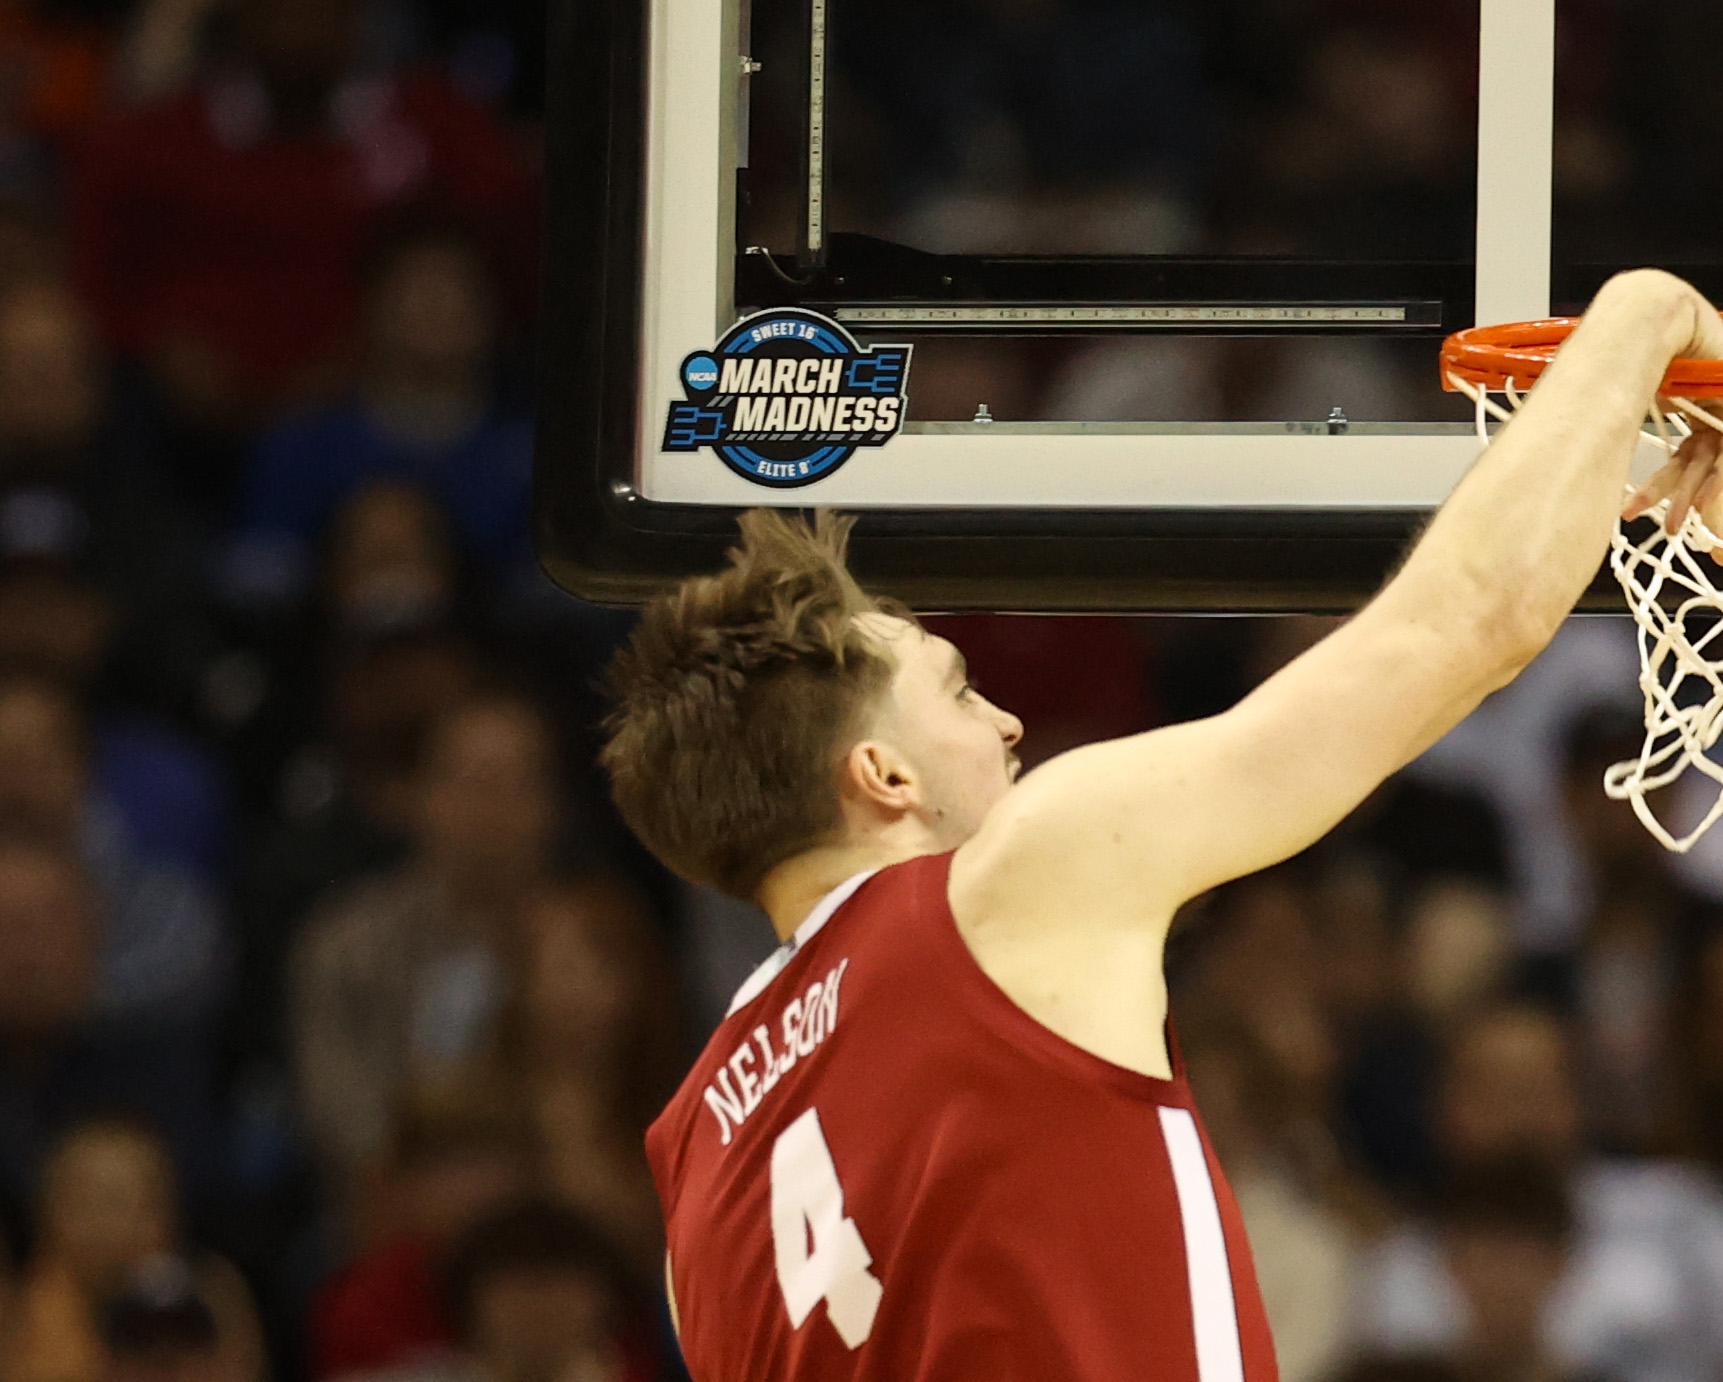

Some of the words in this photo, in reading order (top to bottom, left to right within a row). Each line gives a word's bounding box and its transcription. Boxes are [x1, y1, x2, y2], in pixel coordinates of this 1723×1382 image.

[751, 322, 796, 342] SWEET
[798, 324, 817, 340] 16
[687, 370, 717, 382] NCAA
[718, 358, 844, 394] MARCH
[733, 397, 899, 432] MADNESS
[756, 461, 796, 477] ELITE
[703, 957, 849, 1146] NELSON
[770, 1106, 884, 1351] 4
